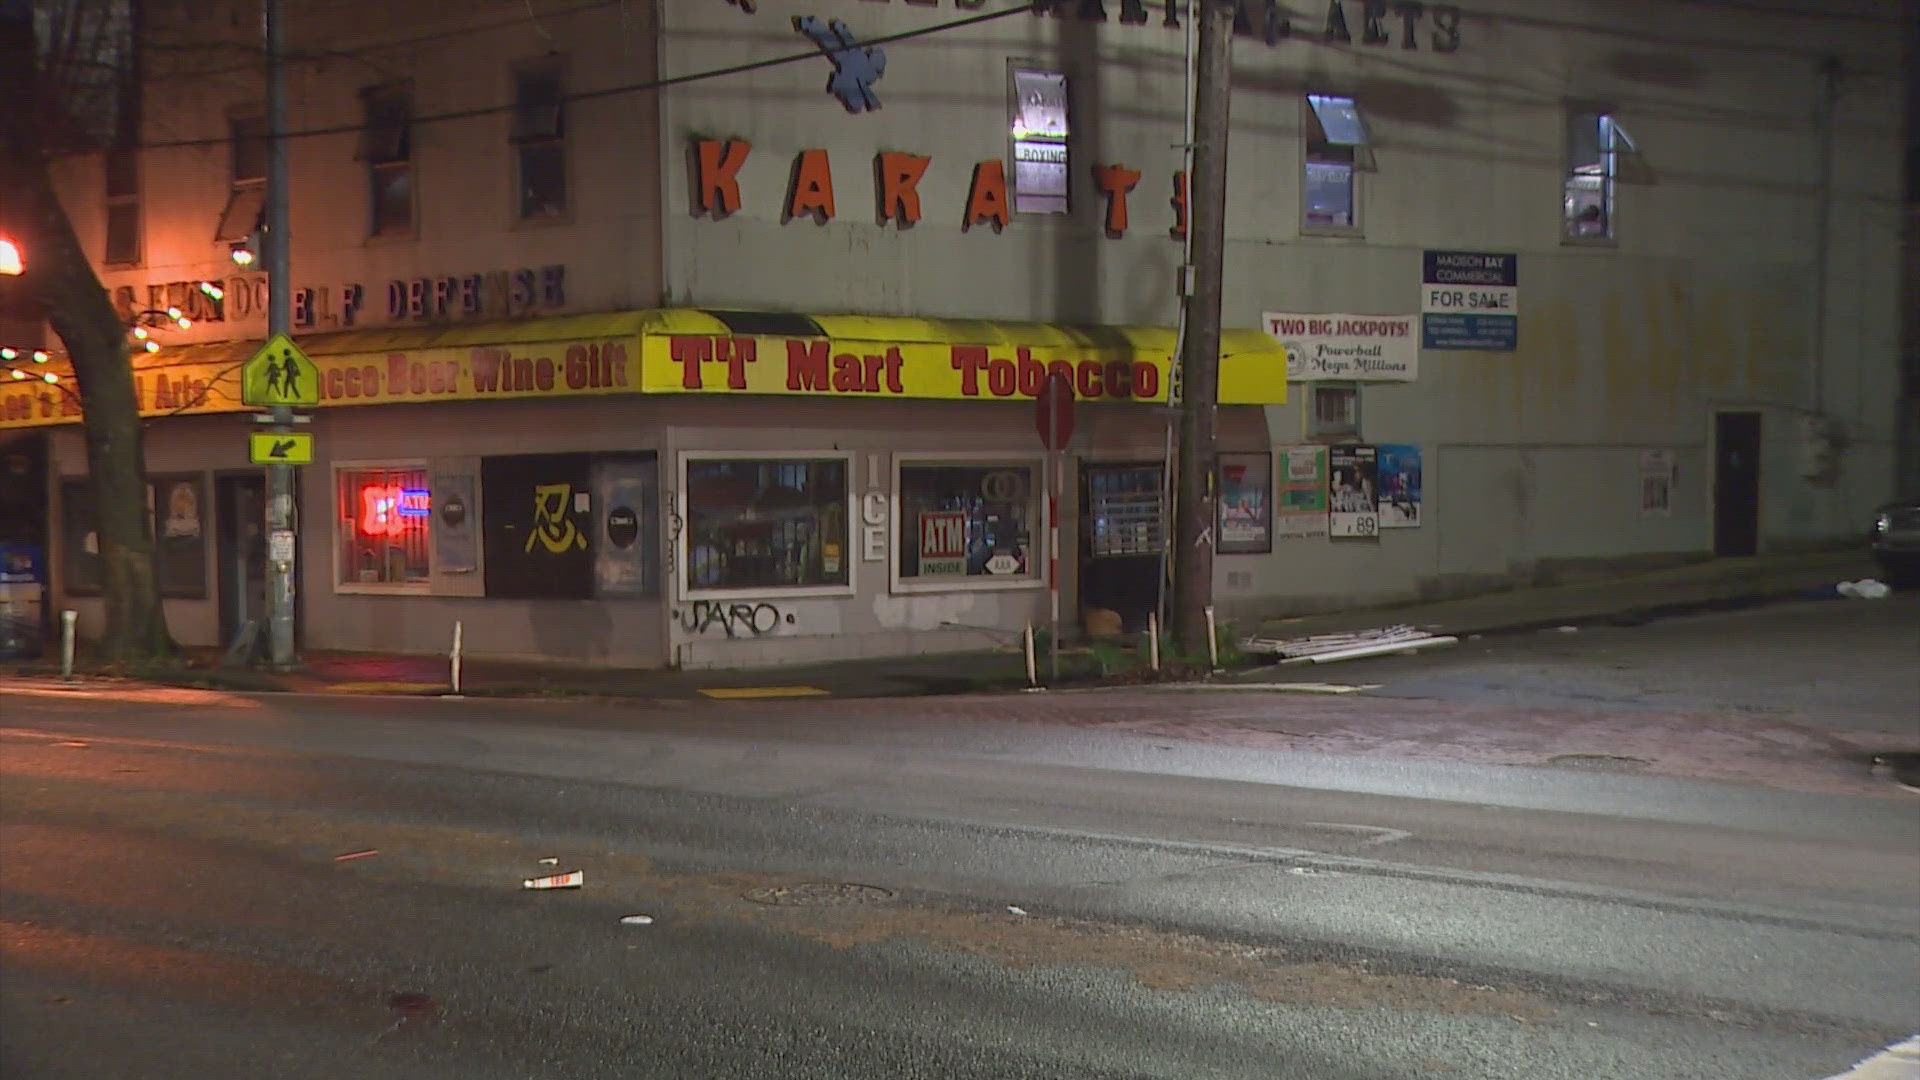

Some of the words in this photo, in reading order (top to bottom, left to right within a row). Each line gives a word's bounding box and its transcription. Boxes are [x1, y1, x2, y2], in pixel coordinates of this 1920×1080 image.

[1023, 148, 1067, 161] BOXING
[1431, 291, 1463, 308] FOR
[1468, 292, 1509, 309] SALE
[1270, 319, 1305, 335] TWO
[1308, 319, 1332, 335] BIG
[1336, 320, 1409, 337] JACKPOTS!
[1316, 343, 1383, 357] Powerball
[471, 345, 555, 393] Wine
[566, 342, 628, 390] Gift
[669, 335, 757, 390] TT
[786, 339, 904, 393] Mart
[1311, 358, 1349, 375] Mega
[1354, 359, 1407, 374] Millions
[862, 454, 886, 562] ICE
[924, 517, 963, 554] ATM
[923, 561, 962, 575] INSIDE
